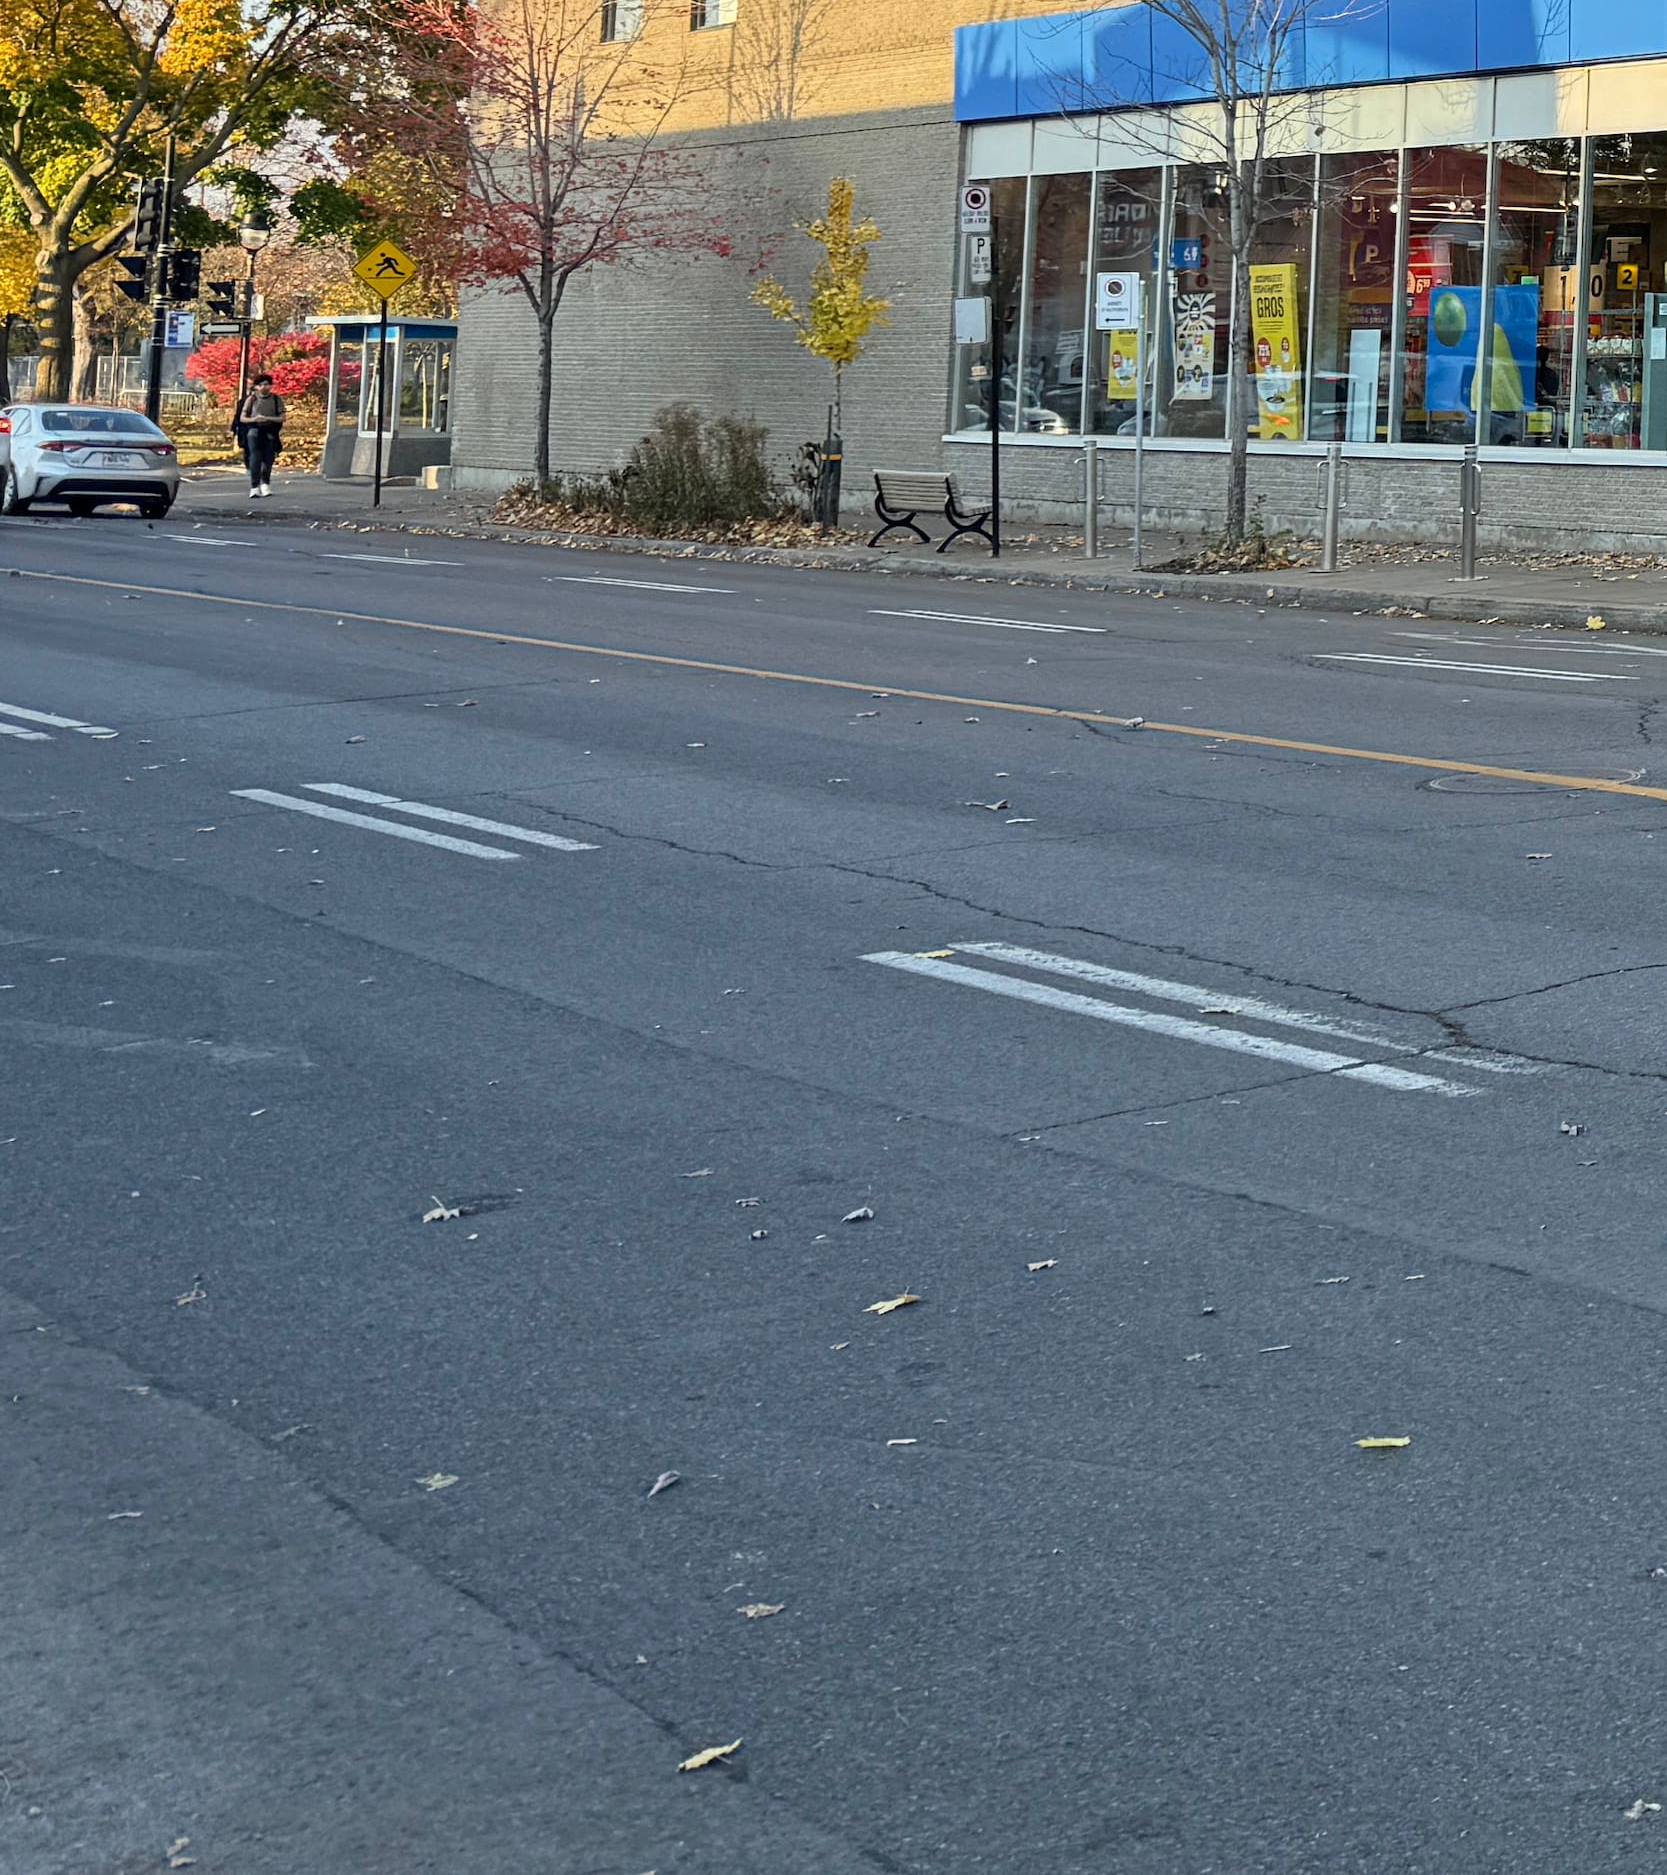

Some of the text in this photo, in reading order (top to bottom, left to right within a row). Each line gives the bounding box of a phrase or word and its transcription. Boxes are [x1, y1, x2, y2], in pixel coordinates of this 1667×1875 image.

[977, 238, 986, 254] P
[1621, 268, 1633, 286] 2
[1256, 296, 1285, 318] GROS
